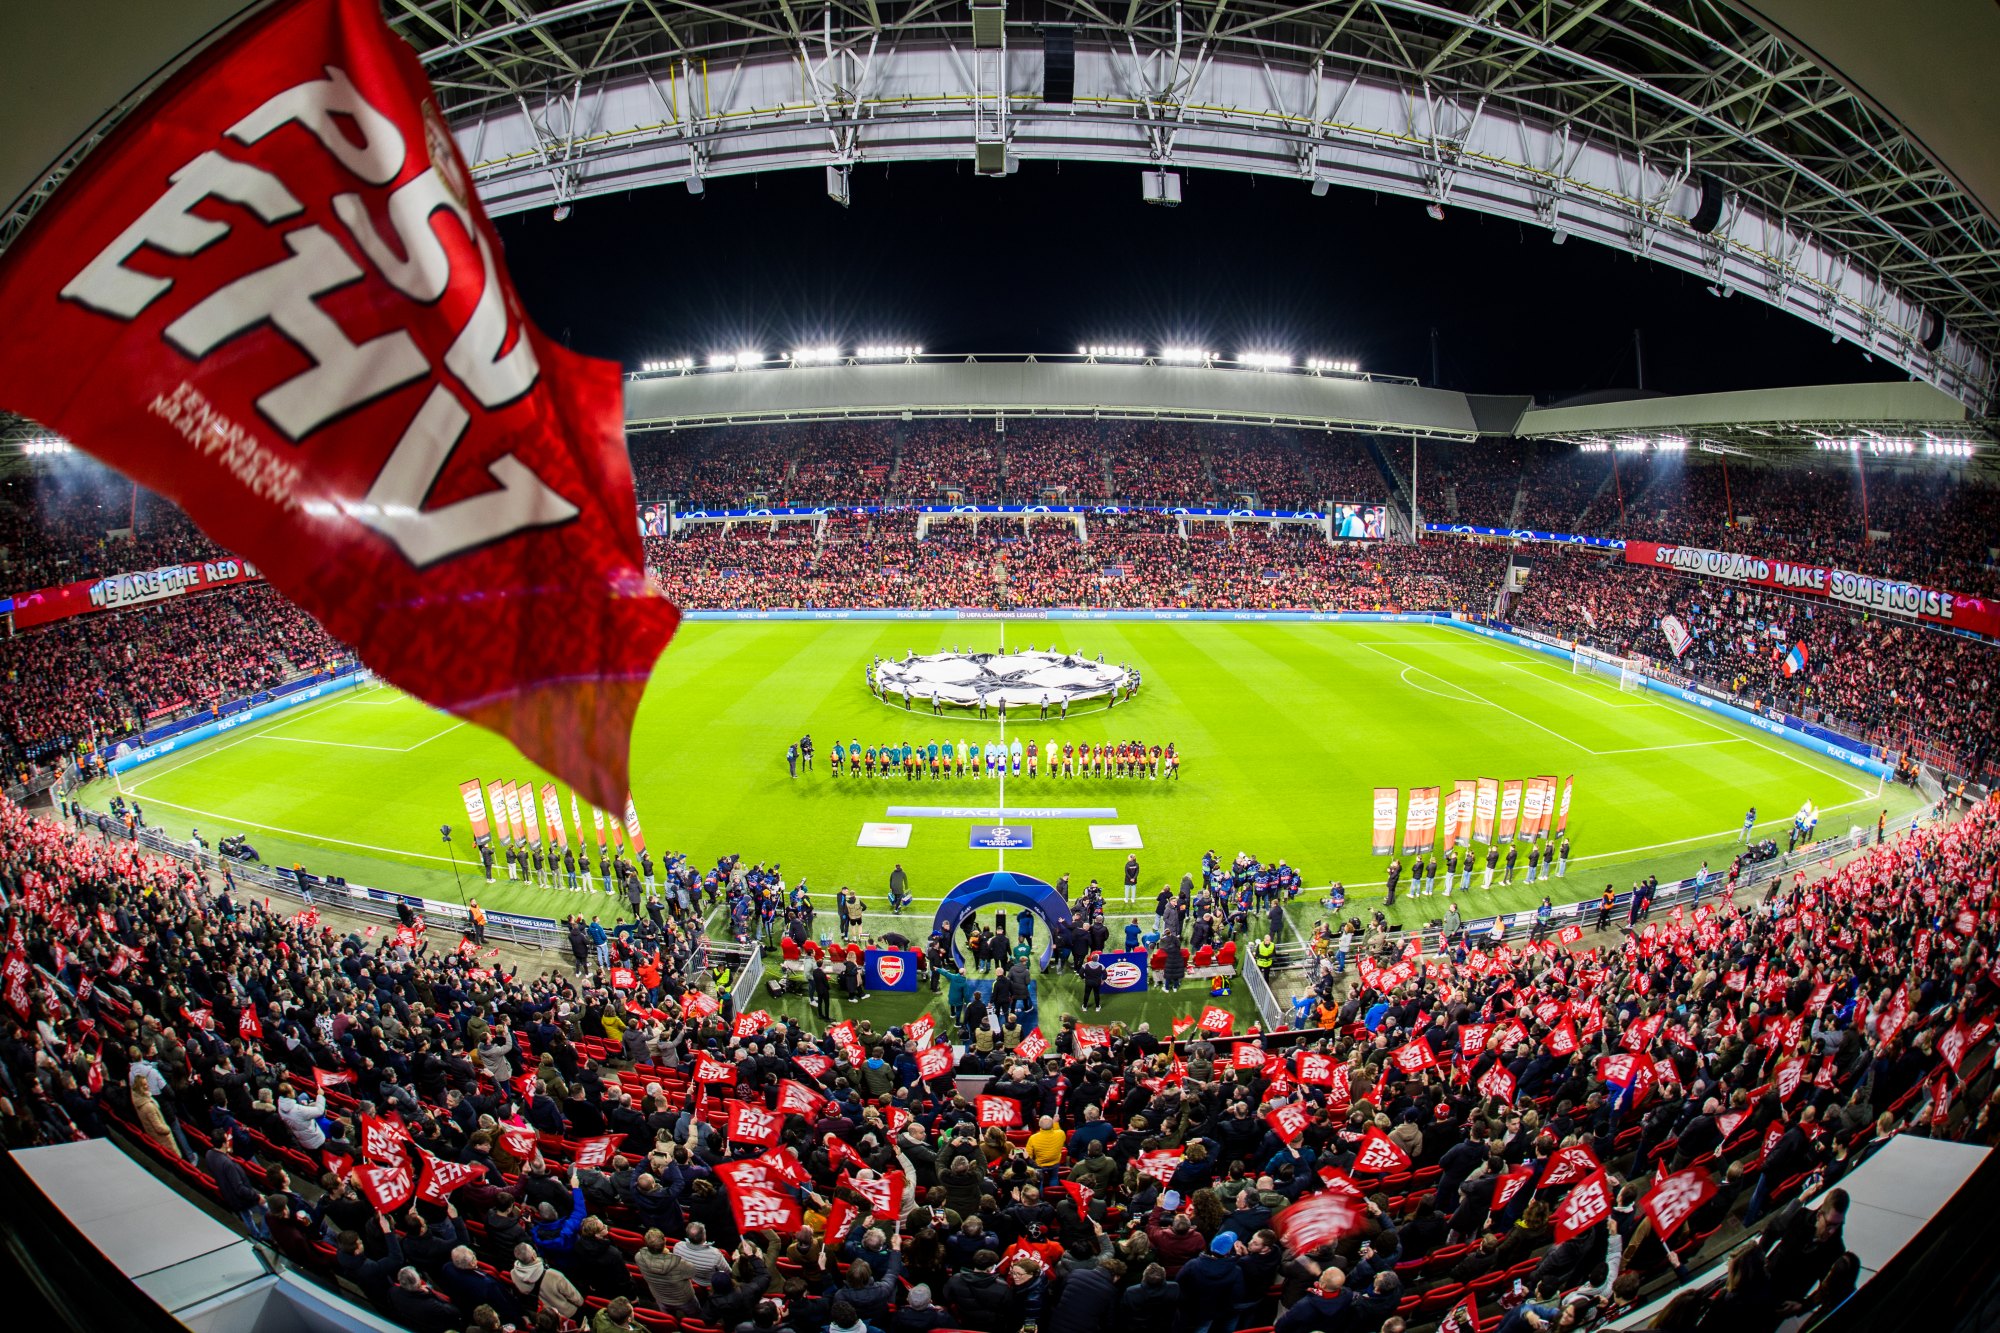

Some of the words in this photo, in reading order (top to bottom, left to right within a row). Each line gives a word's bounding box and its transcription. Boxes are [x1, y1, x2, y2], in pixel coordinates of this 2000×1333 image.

[223, 64, 540, 408] PSV
[59, 150, 580, 569] EHV
[89, 579, 119, 605] WE
[123, 573, 160, 599] ARE
[161, 566, 200, 590] THE
[205, 560, 239, 583] RED
[1655, 546, 1702, 569] STAND
[1708, 552, 1732, 573] UP
[1734, 557, 1769, 580] AND
[1774, 563, 1825, 591] MAKE
[1831, 570, 1885, 605] SOME
[1889, 584, 1955, 618] NOISE
[941, 808, 998, 817] PEACE
[1202, 1018, 1228, 1029] EHV
[1207, 1010, 1229, 1021] PSV
[1020, 1033, 1038, 1053] PSV
[1027, 1040, 1045, 1061] EHV
[922, 1059, 948, 1076] EHV
[1302, 1067, 1330, 1079] EHV
[739, 1108, 775, 1126] PSV
[982, 1108, 1015, 1123] EHV
[736, 1122, 773, 1139] EHV
[1360, 1150, 1402, 1168] EHV
[376, 1168, 411, 1205] EHV
[739, 1195, 783, 1212] PSV
[743, 1209, 791, 1228] EHV
